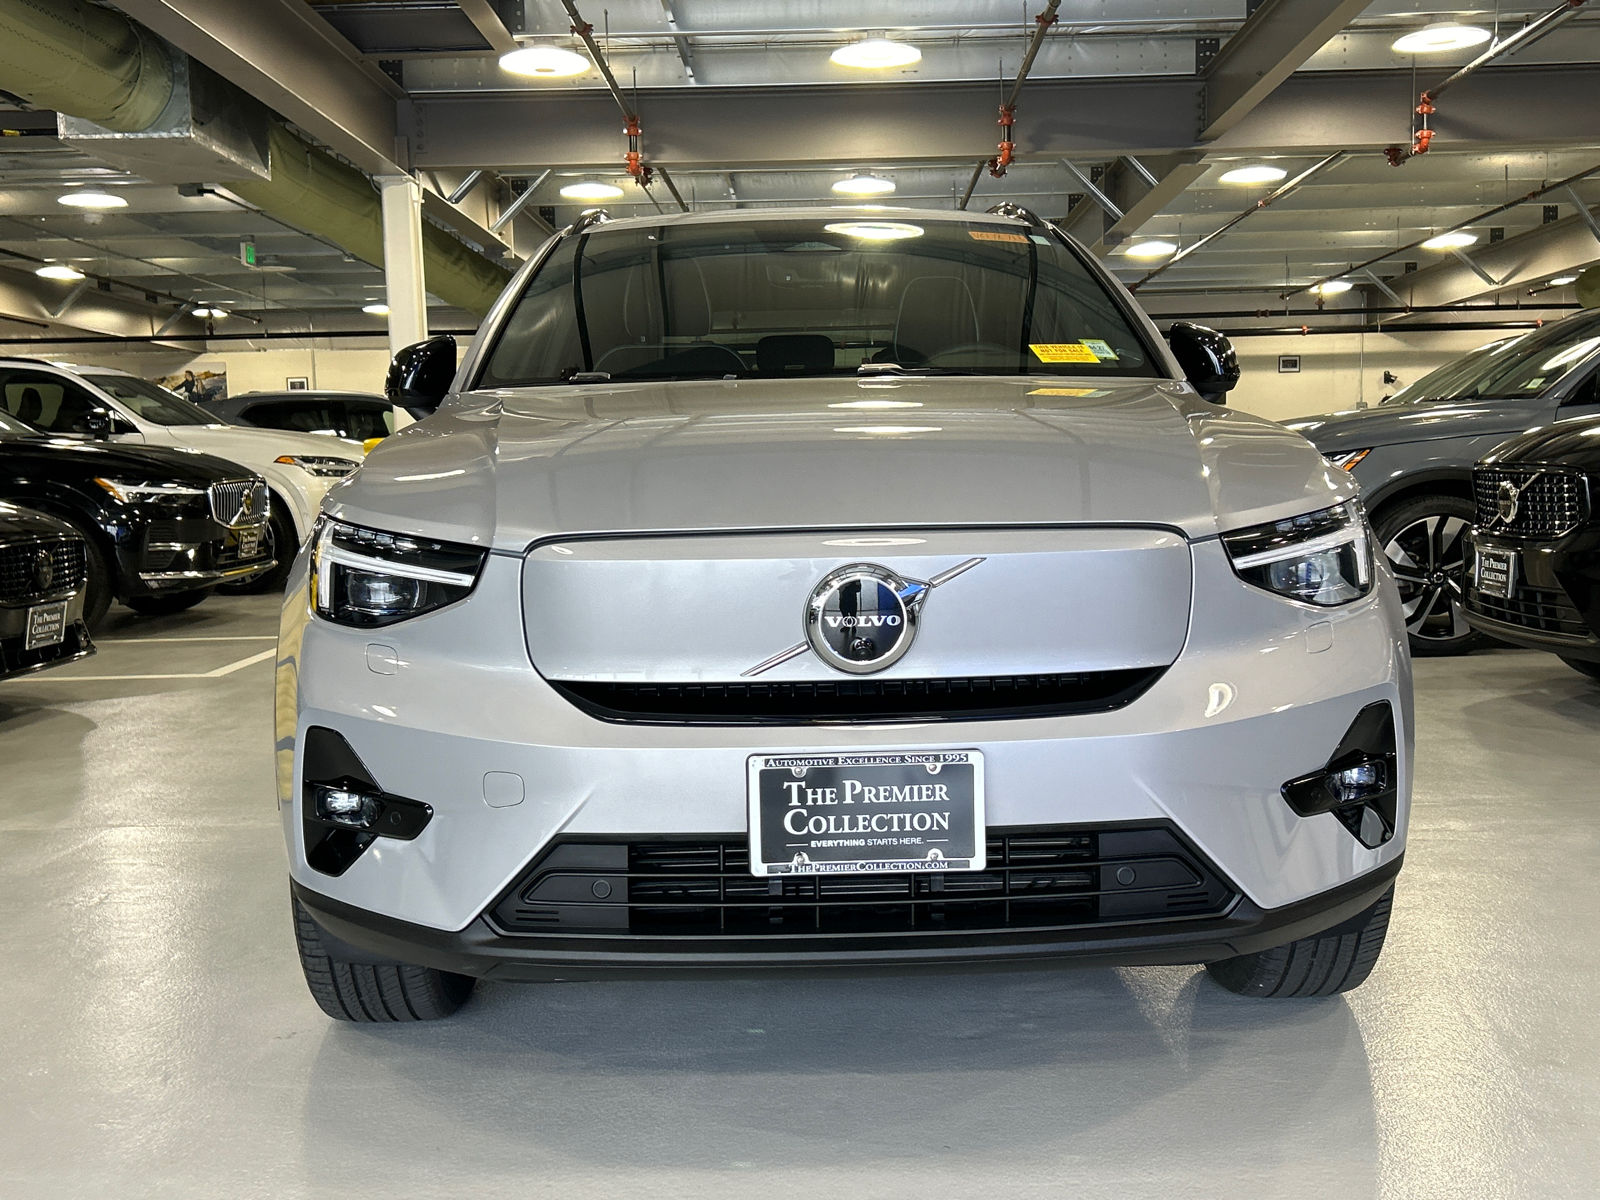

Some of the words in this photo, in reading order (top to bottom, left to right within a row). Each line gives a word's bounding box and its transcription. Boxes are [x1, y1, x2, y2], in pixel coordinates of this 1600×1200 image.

[824, 615, 901, 628] VOLVO
[767, 758, 835, 767] AUTOMOTIVE
[904, 754, 935, 763] SINCE
[939, 753, 967, 762] 1995
[783, 781, 838, 806] THE
[842, 779, 950, 804] PREMIER
[783, 808, 950, 835] COLLECTION
[810, 839, 865, 847] EVERYTHING
[866, 838, 899, 846] STARTS
[899, 837, 924, 845] HERE.
